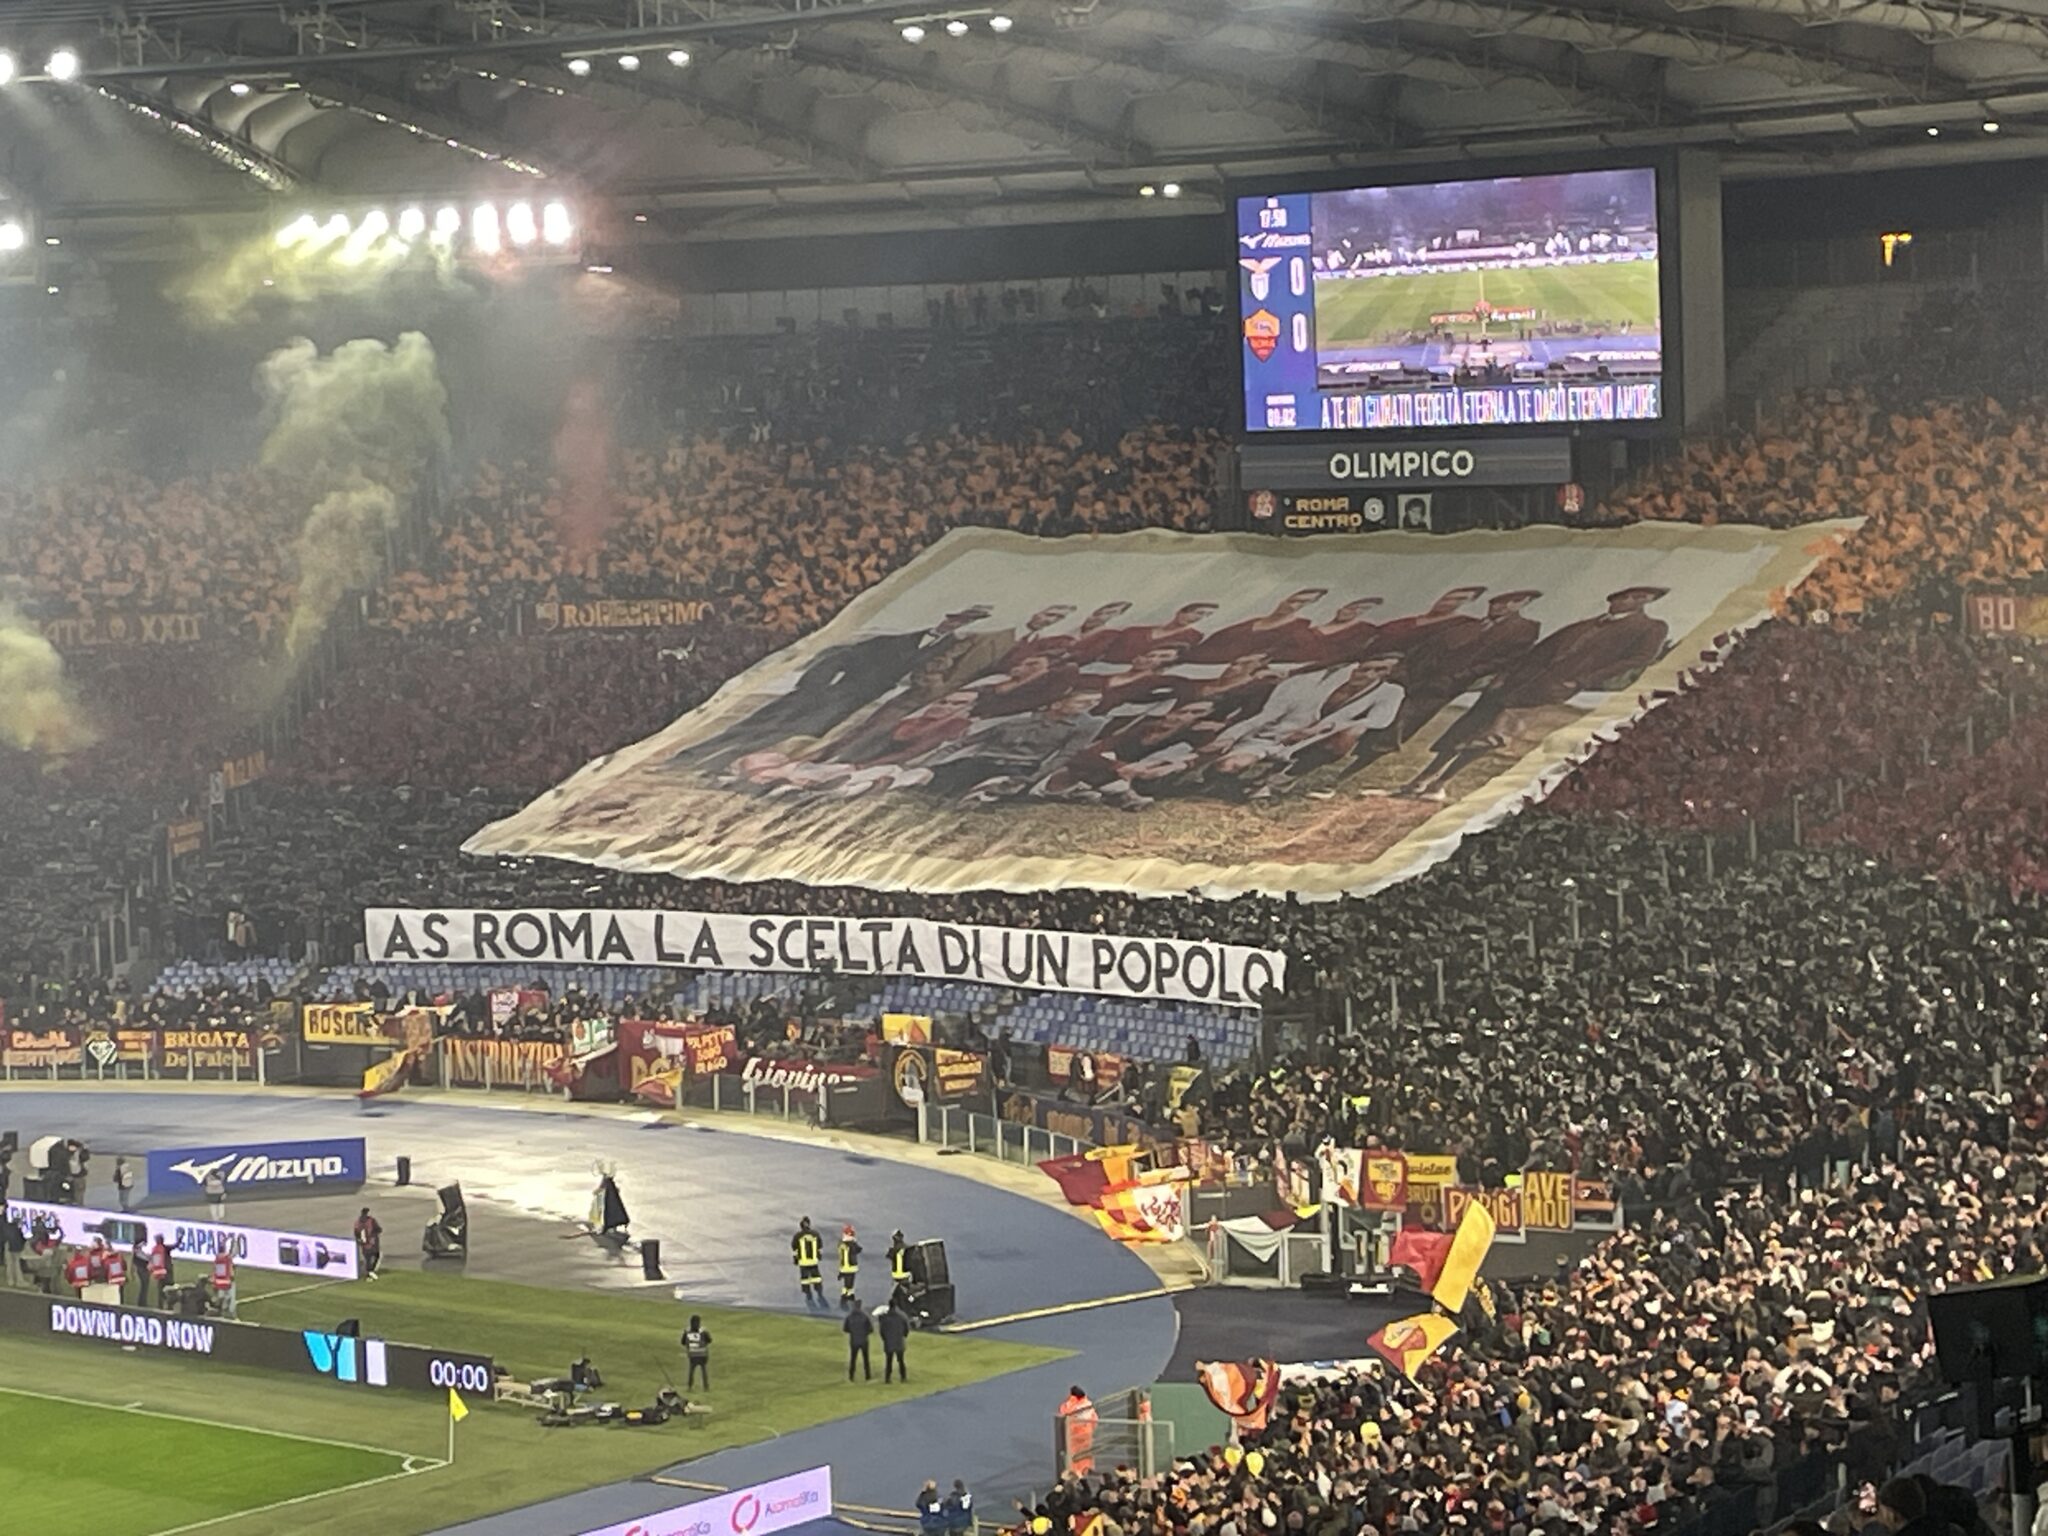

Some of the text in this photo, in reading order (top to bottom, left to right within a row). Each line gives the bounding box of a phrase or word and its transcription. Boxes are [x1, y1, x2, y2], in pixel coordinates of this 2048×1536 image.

[1329, 450, 1474, 479] OLIMPICO
[1296, 497, 1349, 512] ROMA
[1284, 513, 1362, 529] CENTRO
[383, 912, 1275, 1002] AS ROMA LA SCELTA DI UN POPOLO
[164, 1031, 250, 1049] BRIGATA
[1525, 1172, 1571, 1200] AVE
[1525, 1199, 1570, 1229] MOU
[52, 1304, 214, 1354] DOWNLOAD NOW
[430, 1359, 489, 1392] 00:00
